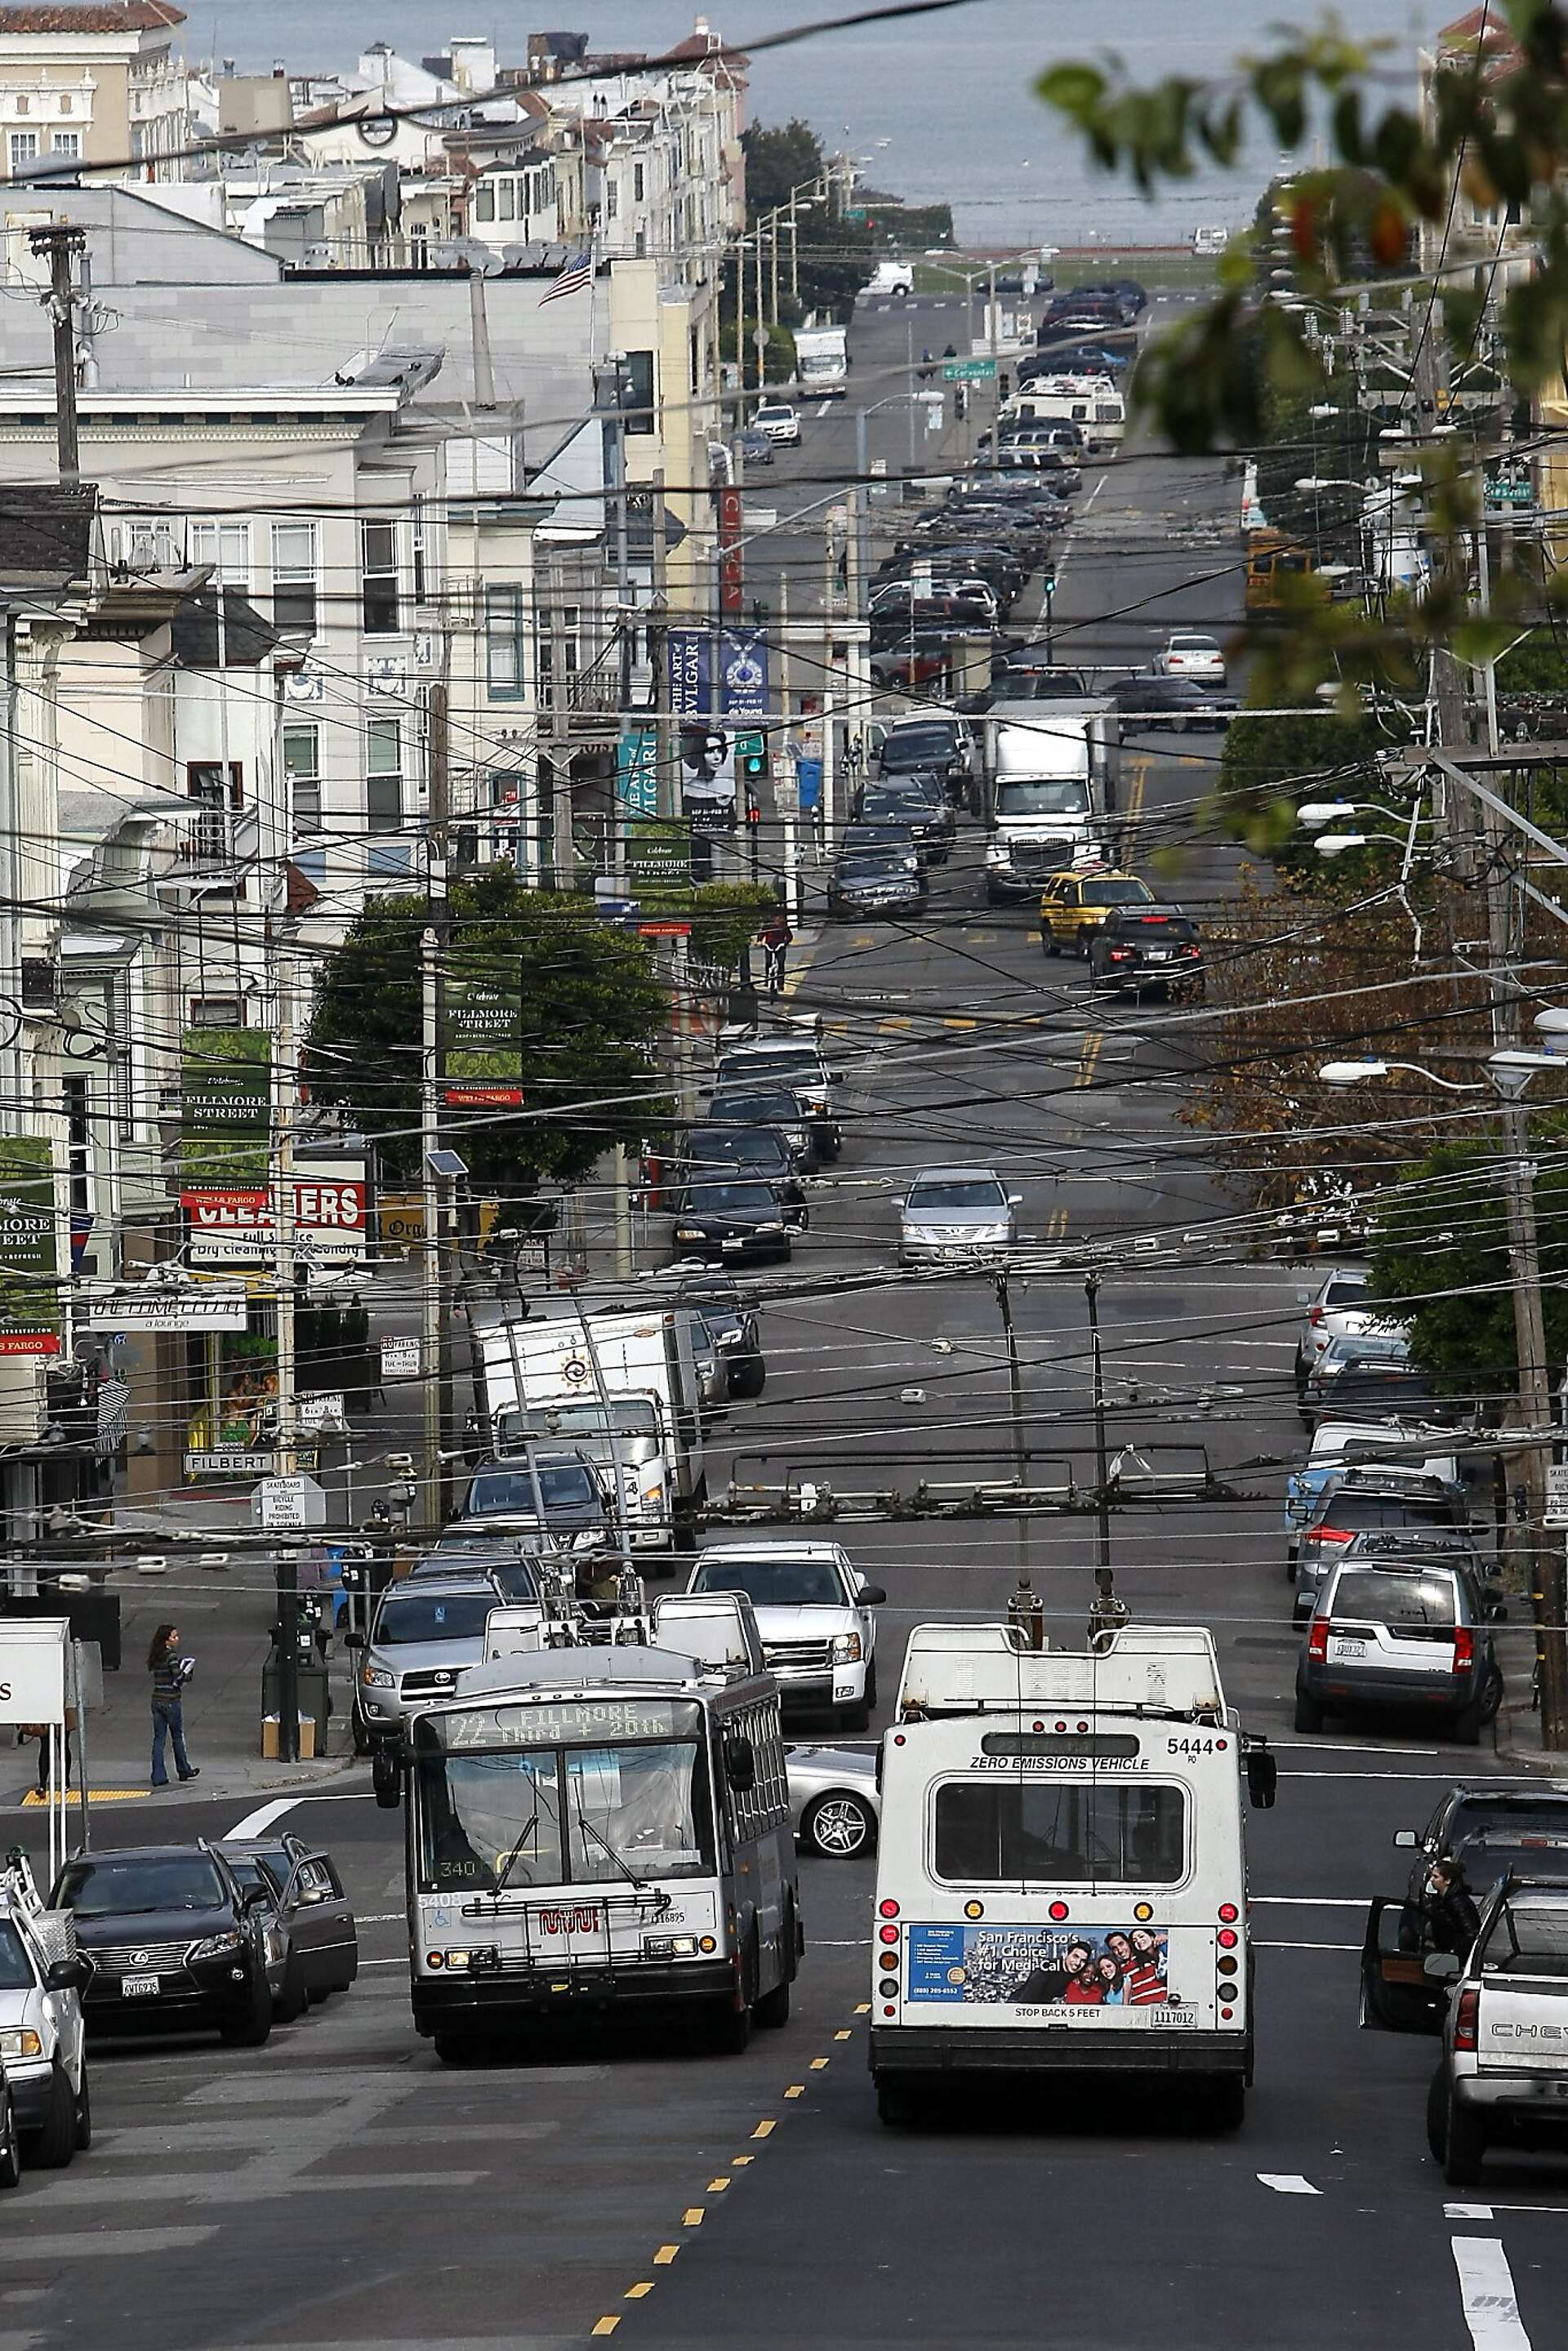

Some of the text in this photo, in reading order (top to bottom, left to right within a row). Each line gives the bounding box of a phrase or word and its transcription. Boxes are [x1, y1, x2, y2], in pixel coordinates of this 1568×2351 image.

[672, 652, 682, 681] ART
[672, 683, 682, 711] THE
[449, 1009, 518, 1019] FILLMORE
[458, 1019, 511, 1029] STREET
[186, 1095, 267, 1106] FILLMORE
[194, 1108, 259, 1119] STREET
[227, 1196, 256, 1204] FARGO
[154, 1319, 189, 1329] lounge
[8, 1341, 43, 1351] FARGO
[191, 1456, 266, 1469] FILBERT
[266, 1480, 301, 1489] SKATEBOARD
[273, 1495, 295, 1503] BICYCLE
[520, 1704, 638, 1727] FILLMORE
[451, 1714, 488, 1747] 22
[501, 1725, 563, 1744] Third
[1167, 1738, 1214, 1755] 5444
[969, 1757, 1150, 1770] ZERO EMISSIONS VEHICLE
[440, 1861, 475, 1877] 340
[978, 1930, 1080, 1944] San Francisco's
[979, 1945, 1047, 1957] #1 Choice
[979, 1960, 1061, 1972] for Medi-Cal
[1015, 2008, 1101, 2019] STOP BACK 5 FEET
[1154, 2010, 1195, 2024] 1117012
